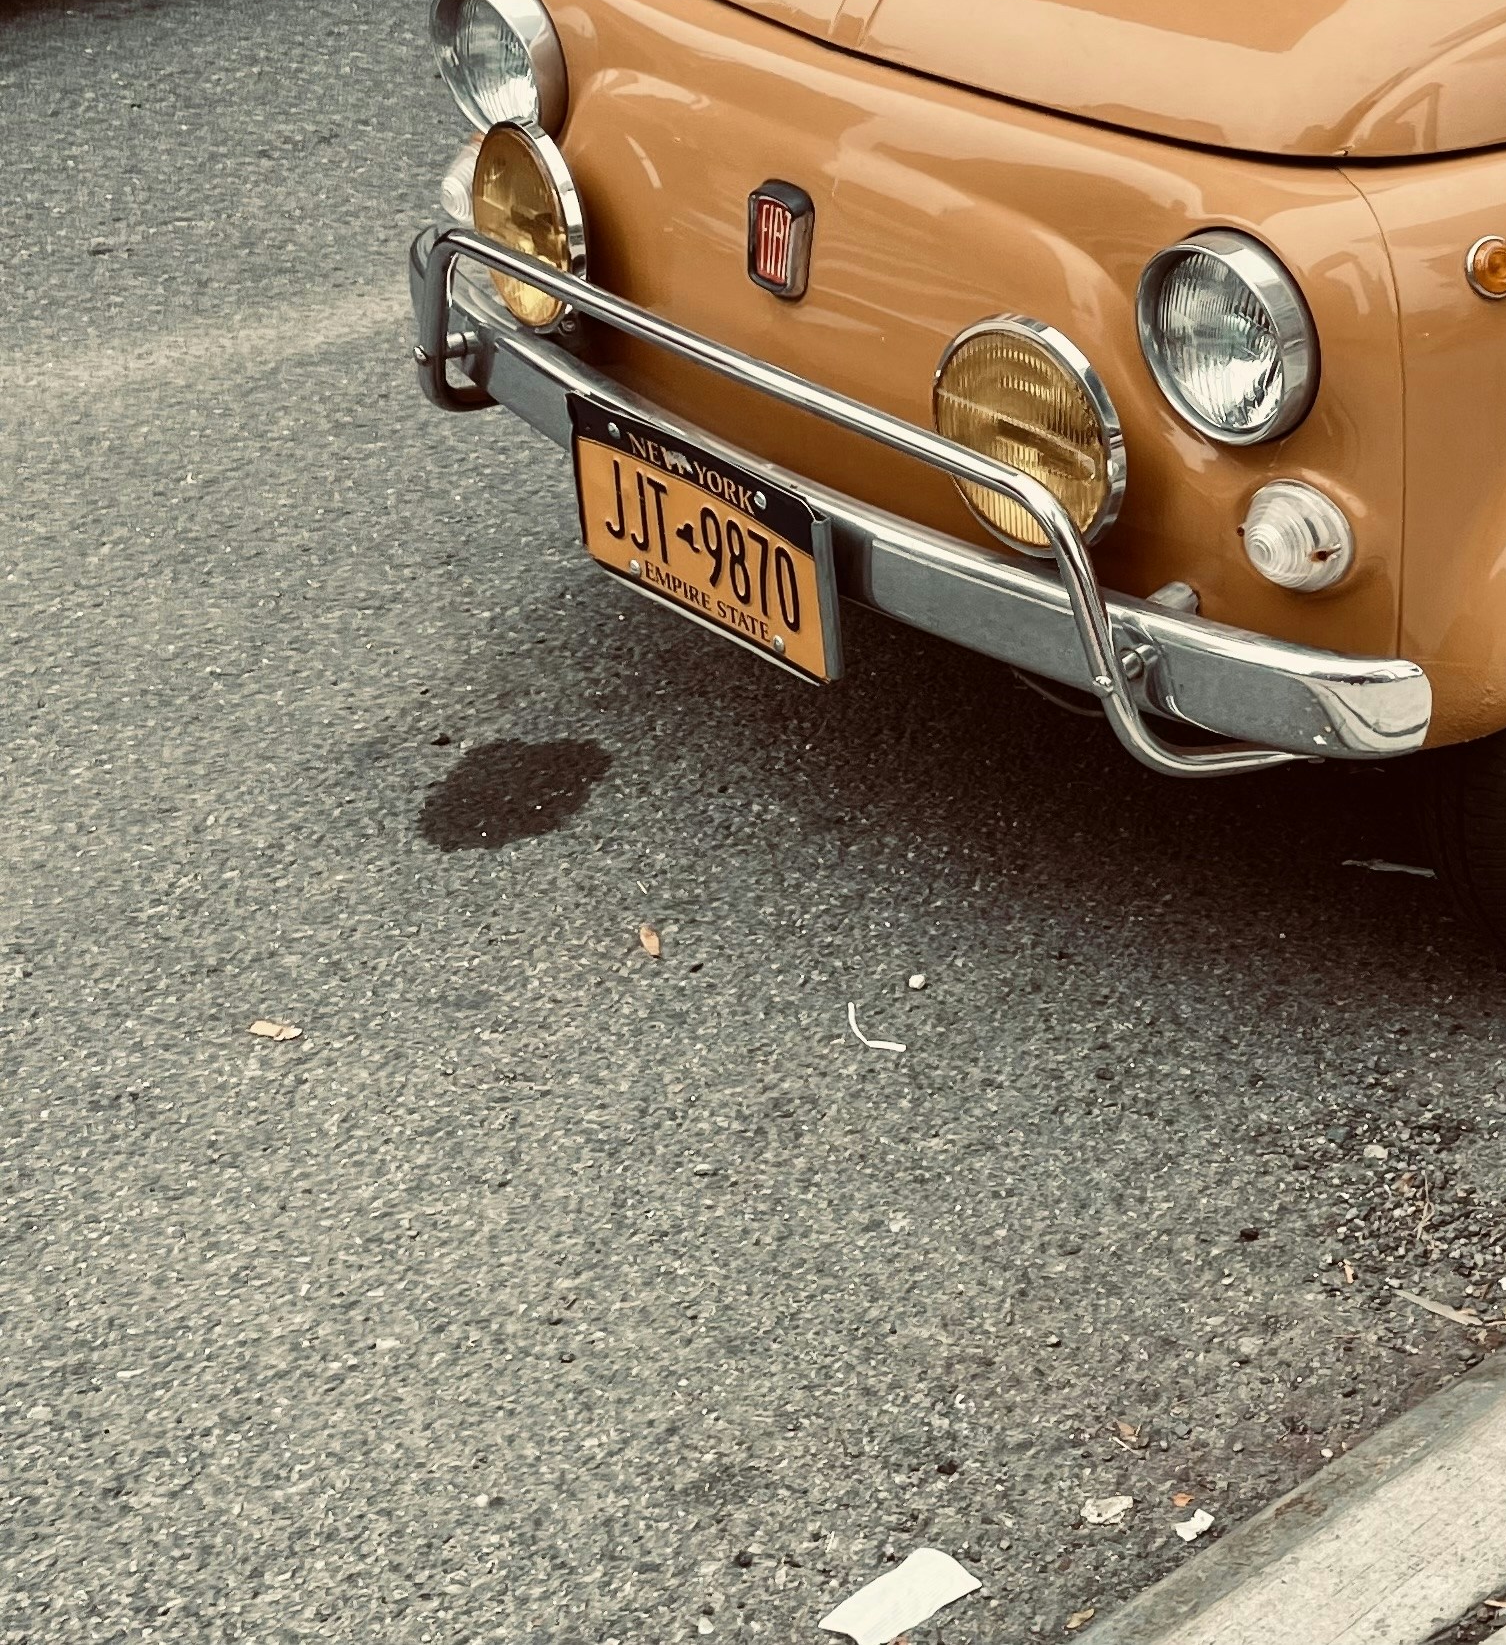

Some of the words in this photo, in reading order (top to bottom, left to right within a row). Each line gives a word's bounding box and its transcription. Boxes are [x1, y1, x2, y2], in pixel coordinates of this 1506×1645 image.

[760, 204, 791, 280] FIAT
[693, 459, 755, 516] YORK
[605, 459, 669, 566] JJT
[700, 506, 800, 634] 9870
[645, 560, 711, 613] EMPIRE
[717, 600, 771, 644] STATE
